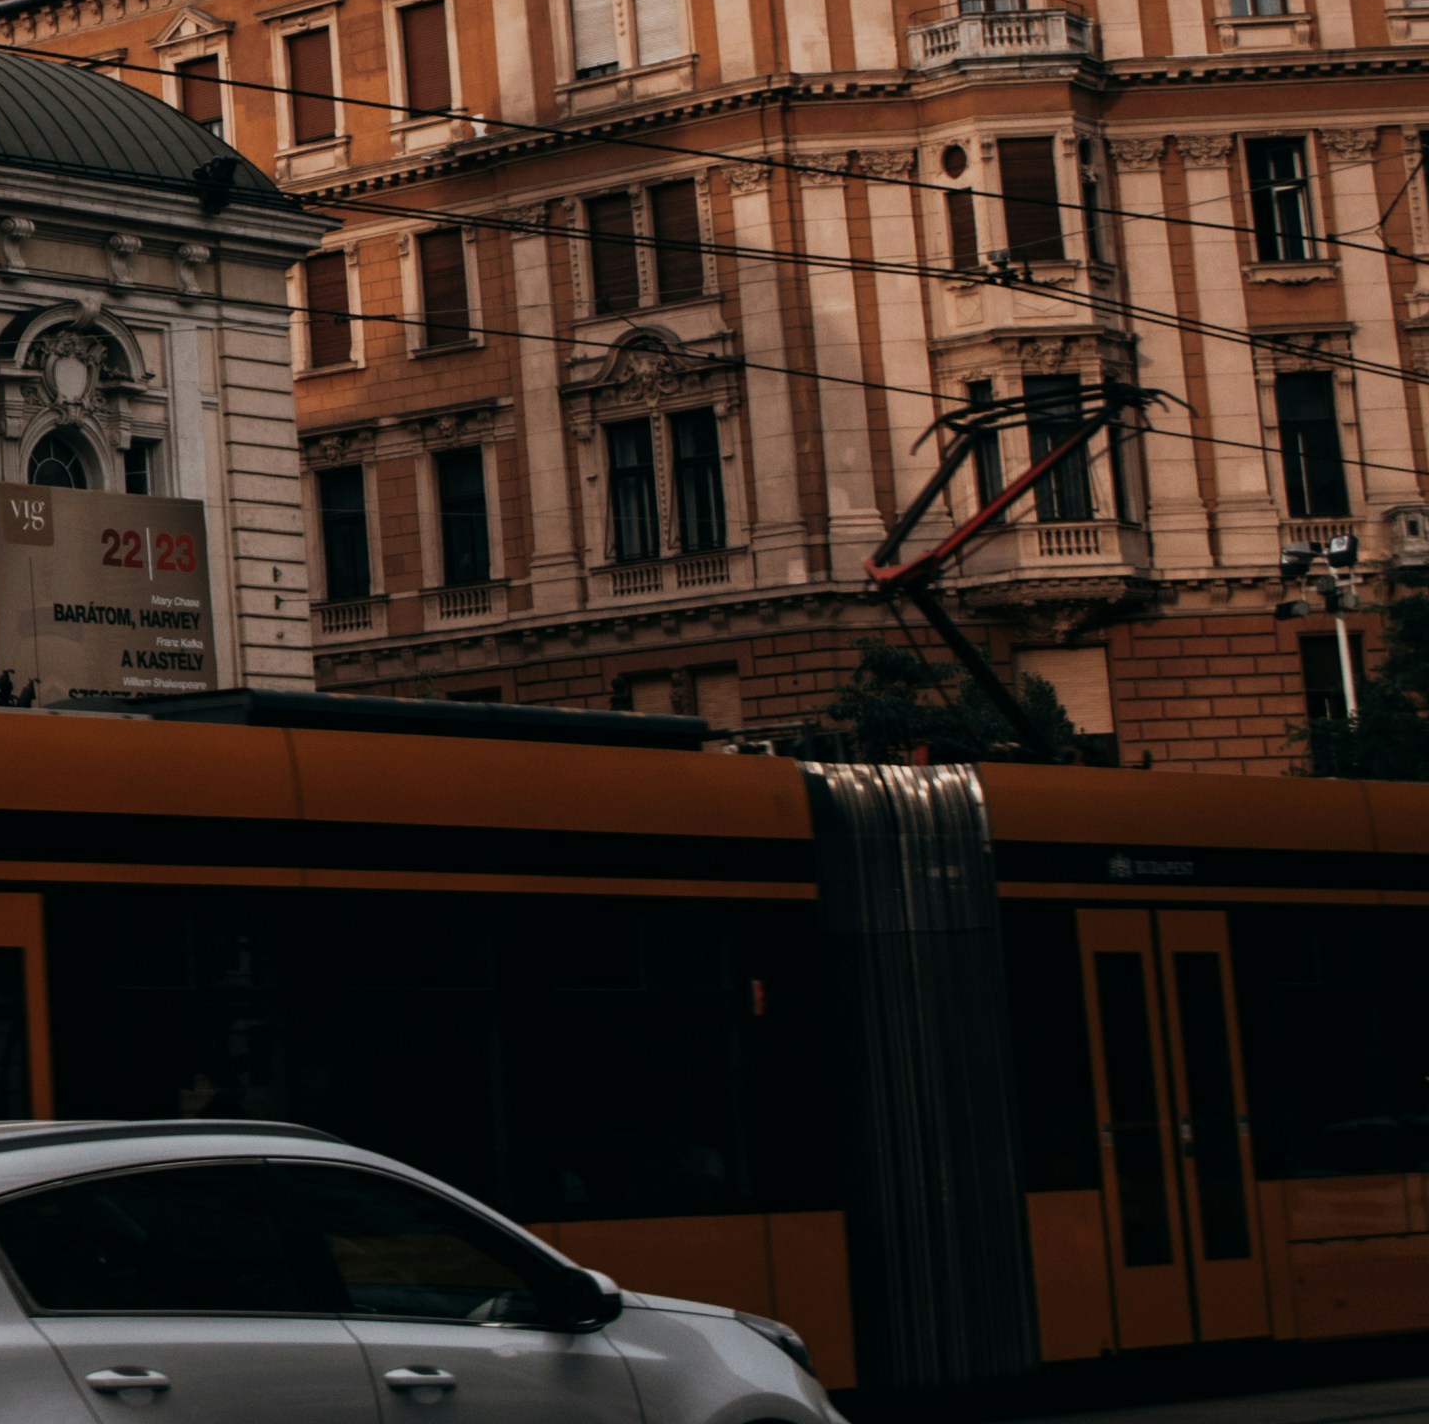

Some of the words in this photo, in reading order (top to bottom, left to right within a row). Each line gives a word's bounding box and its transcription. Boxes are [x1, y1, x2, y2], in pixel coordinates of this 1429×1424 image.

[151, 595, 171, 607] Mary
[174, 596, 200, 608] Chase
[53, 601, 136, 630] BARÁTOM,
[139, 609, 201, 630] HARVEY
[156, 637, 178, 647] Franz
[180, 638, 204, 649] Kafka
[121, 650, 132, 668] A
[137, 648, 204, 671] KASTÉLY
[122, 676, 151, 687] William
[153, 677, 207, 690] Shakespeare
